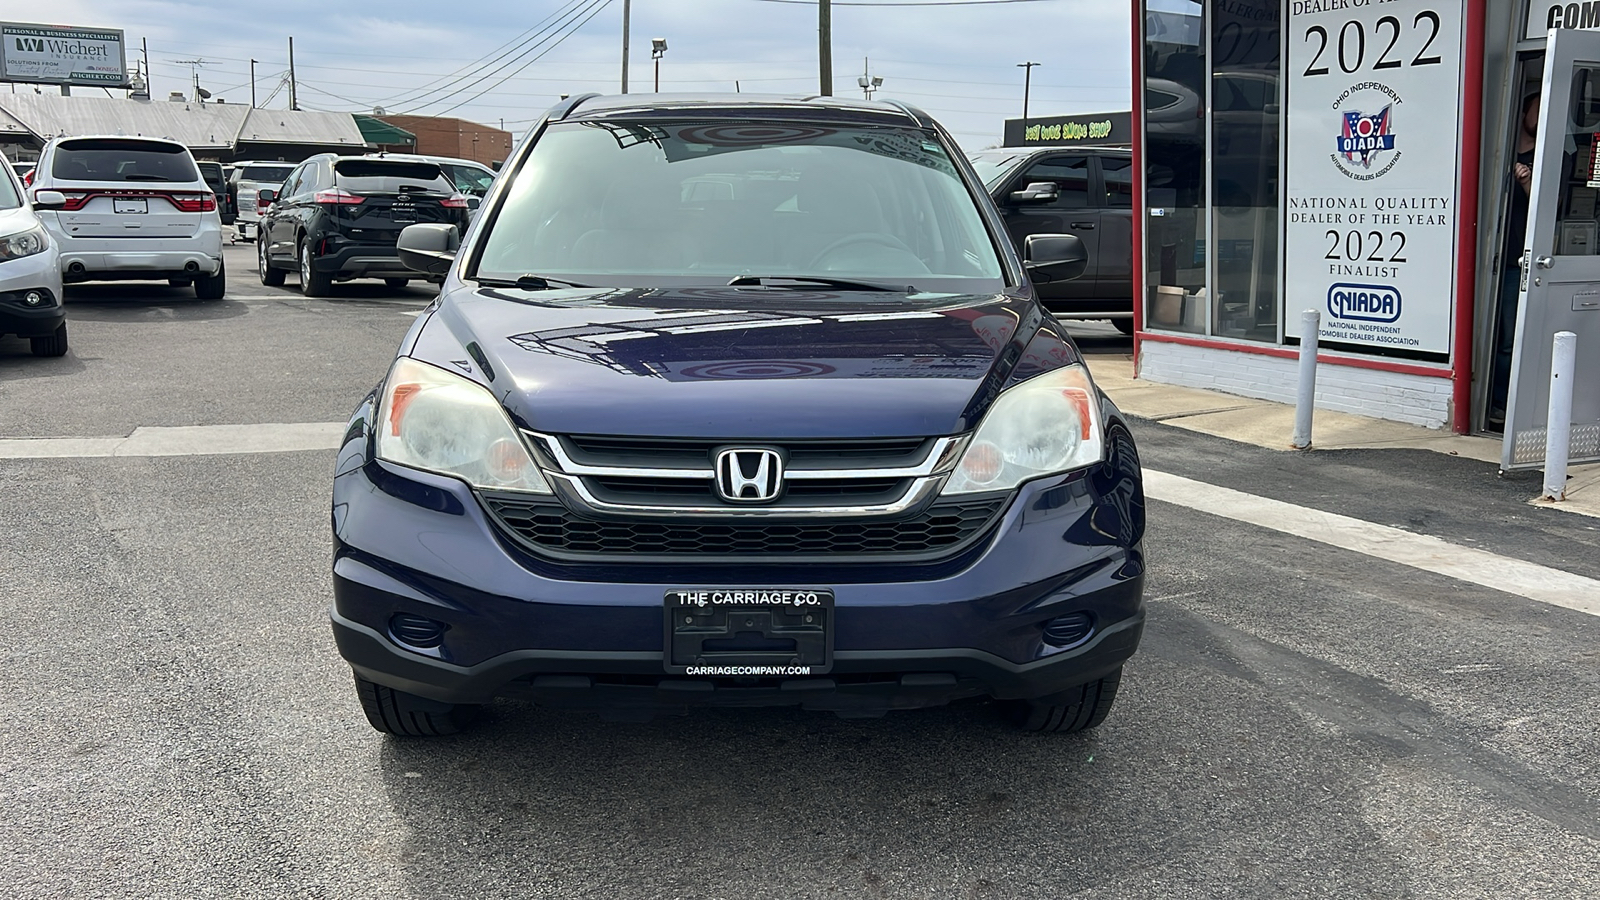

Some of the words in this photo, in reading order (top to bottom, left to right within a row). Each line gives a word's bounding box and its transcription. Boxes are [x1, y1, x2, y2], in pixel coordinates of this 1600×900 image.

[1293, 0, 1349, 16] DEALER
[3, 28, 38, 36] PERSONAL
[46, 39, 108, 57] Wichert
[1303, 10, 1441, 77] 2022
[71, 72, 121, 80] WICHERT.COM
[1332, 90, 1350, 110] OHIO
[1350, 81, 1403, 105] INDEPENDENT
[1089, 119, 1112, 139] SHOP
[1343, 136, 1385, 151] OIADA
[1330, 153, 1354, 179] AUTOMOBILE
[1353, 173, 1375, 181] DEALERS
[1375, 150, 1402, 178] ASSOCIATION
[1289, 197, 1367, 209] NATIONAL
[1374, 197, 1449, 211] QUALITY
[1291, 213, 1342, 223] DEALER
[1348, 213, 1366, 224] OF
[1372, 214, 1400, 225] THE
[1407, 214, 1446, 225] YEAR
[1324, 229, 1407, 263] 2022
[1329, 264, 1399, 278] FINALIST
[1333, 290, 1394, 316] NIADA
[1327, 321, 1358, 331] NATIONAL
[1358, 324, 1400, 334] INDEPENDENT
[1318, 329, 1348, 339] TOMOBILE
[1349, 332, 1375, 341] DEALERS
[1376, 335, 1420, 346] ASSOCIATION
[677, 592, 708, 605] THE
[711, 592, 791, 605] CARRIAGE
[794, 592, 821, 605] CO.
[685, 666, 811, 675] CARRIAGECOMPANY.COM
